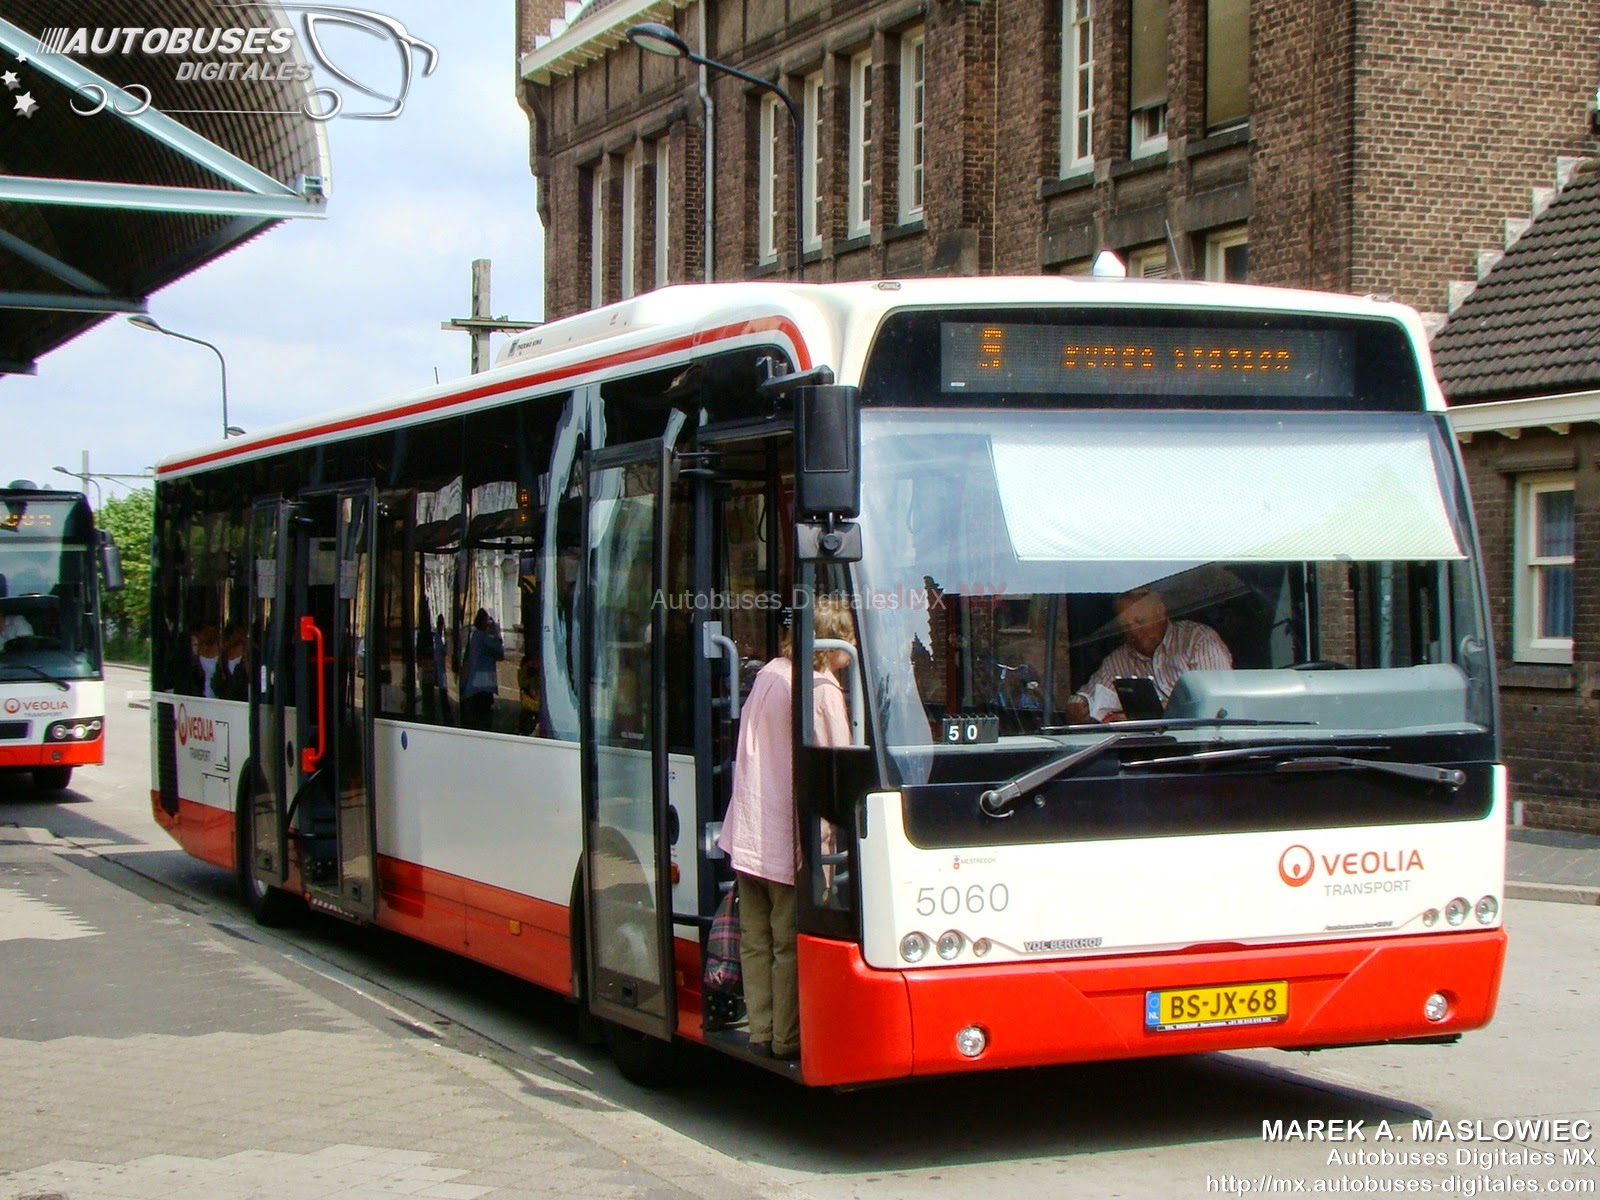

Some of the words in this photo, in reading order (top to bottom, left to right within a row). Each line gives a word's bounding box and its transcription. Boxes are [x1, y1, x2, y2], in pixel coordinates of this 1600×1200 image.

[23, 701, 69, 710] VEOLIA
[187, 716, 215, 742] VEOLIA
[1322, 849, 1424, 876] VEOLIA
[916, 883, 1009, 916] 5060
[1324, 879, 1411, 897] TRANSPORT
[1024, 941, 1048, 951] VDL
[1050, 937, 1103, 949] BERKHOF
[1171, 988, 1277, 1019] BS-JX-68
